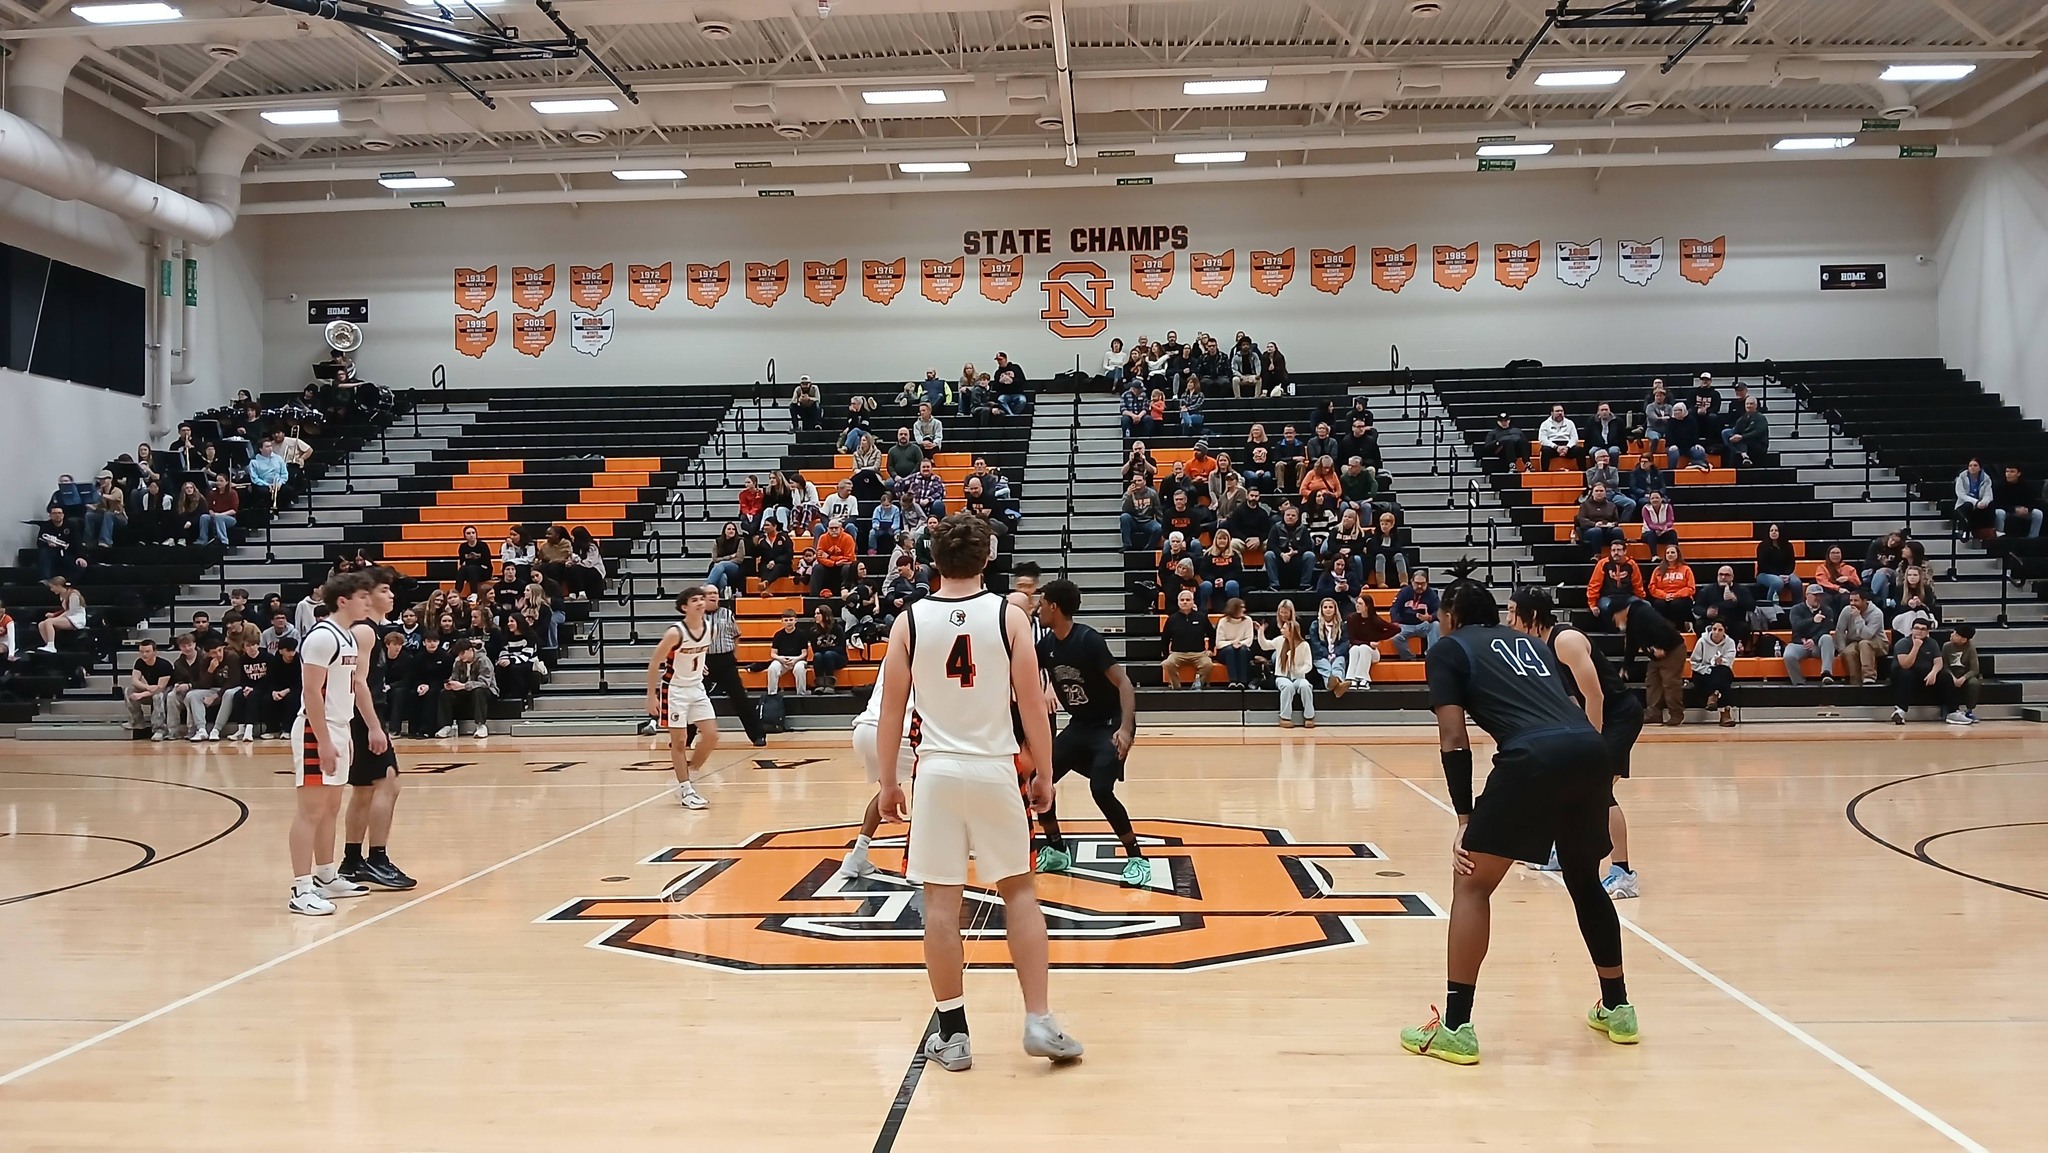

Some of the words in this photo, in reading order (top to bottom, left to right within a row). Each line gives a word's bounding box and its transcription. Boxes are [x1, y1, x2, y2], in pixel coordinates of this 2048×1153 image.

[963, 229, 1052, 255] STATE
[1070, 225, 1189, 252] CHAMPS
[1692, 246, 1713, 254] 1996
[1323, 255, 1343, 263] 1980
[1142, 260, 1162, 268] 1978
[699, 270, 719, 278] 1973
[757, 269, 777, 277] 1974
[1840, 272, 1866, 280] HOME
[326, 307, 350, 316] HOME
[466, 320, 486, 328] 1999
[524, 319, 544, 327] 2003
[946, 634, 976, 688] 4
[1490, 638, 1551, 676] 14
[243, 662, 268, 672] EAGLE
[691, 656, 699, 672] 1
